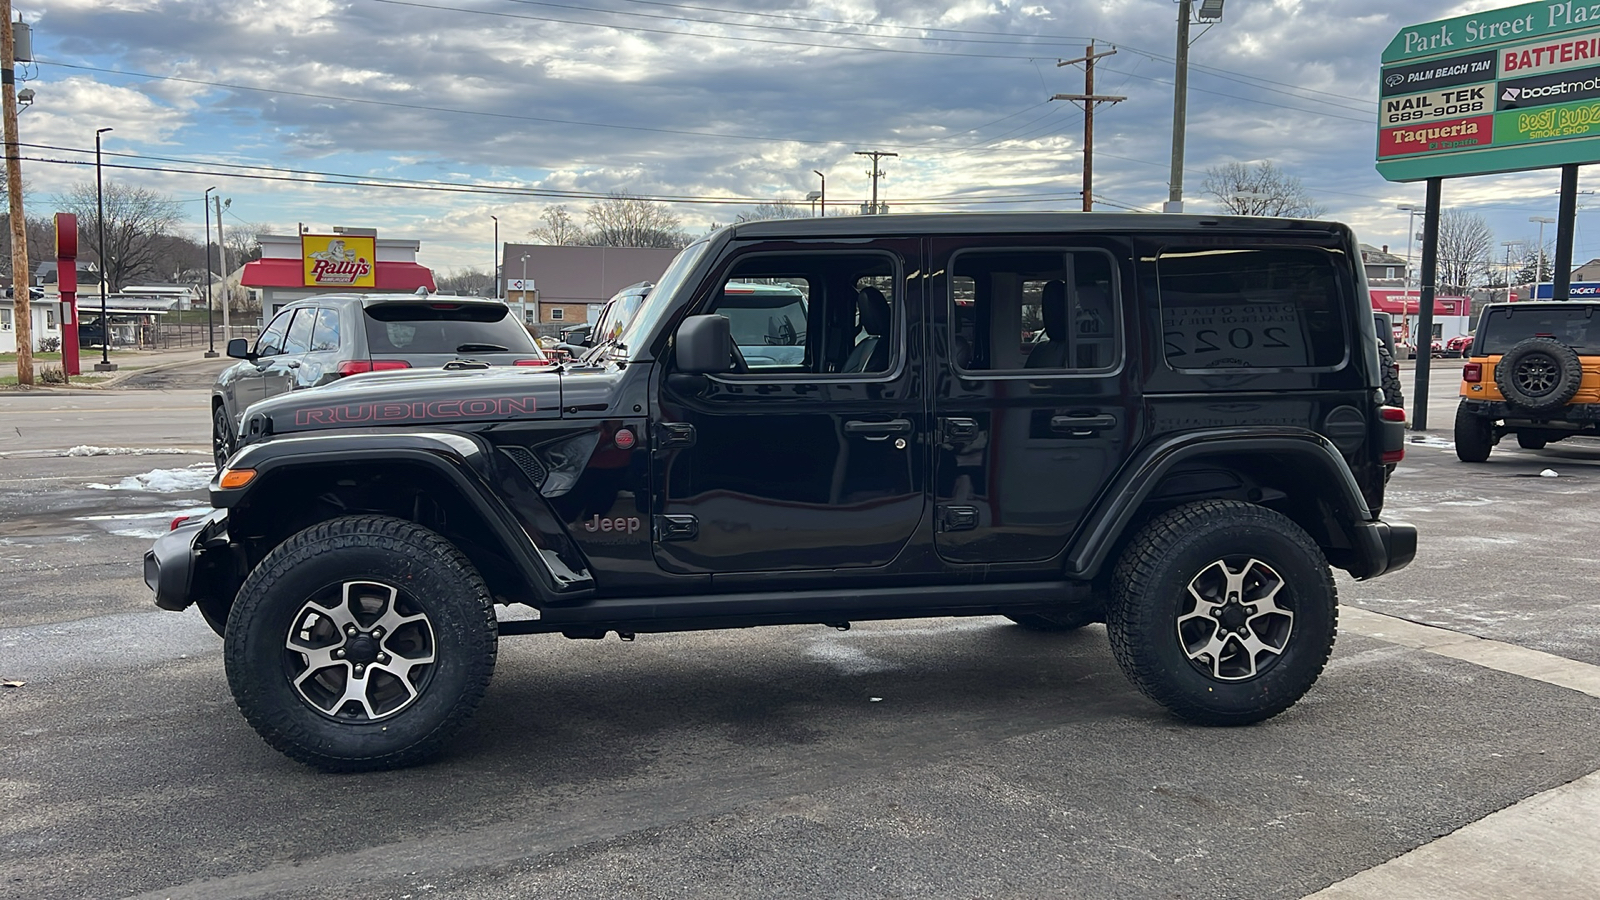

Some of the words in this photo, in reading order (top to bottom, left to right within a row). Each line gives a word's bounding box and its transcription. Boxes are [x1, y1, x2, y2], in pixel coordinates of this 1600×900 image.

[1404, 24, 1454, 54] Park
[1465, 13, 1534, 43] Street
[1504, 38, 1600, 72] BATTERI
[1407, 69, 1434, 83] PALM
[1434, 63, 1469, 79] BEACH
[1470, 59, 1491, 73] TAN
[1387, 96, 1433, 113] NAIL
[1441, 86, 1486, 104] TEK
[1388, 101, 1484, 123] 689-9088
[1558, 103, 1600, 128] BUDZ
[1529, 128, 1561, 139] SMOKE
[1562, 125, 1590, 136] SHOP
[310, 257, 370, 283] Rally's
[295, 397, 536, 426] RUBICON
[584, 514, 641, 535] Jeep
